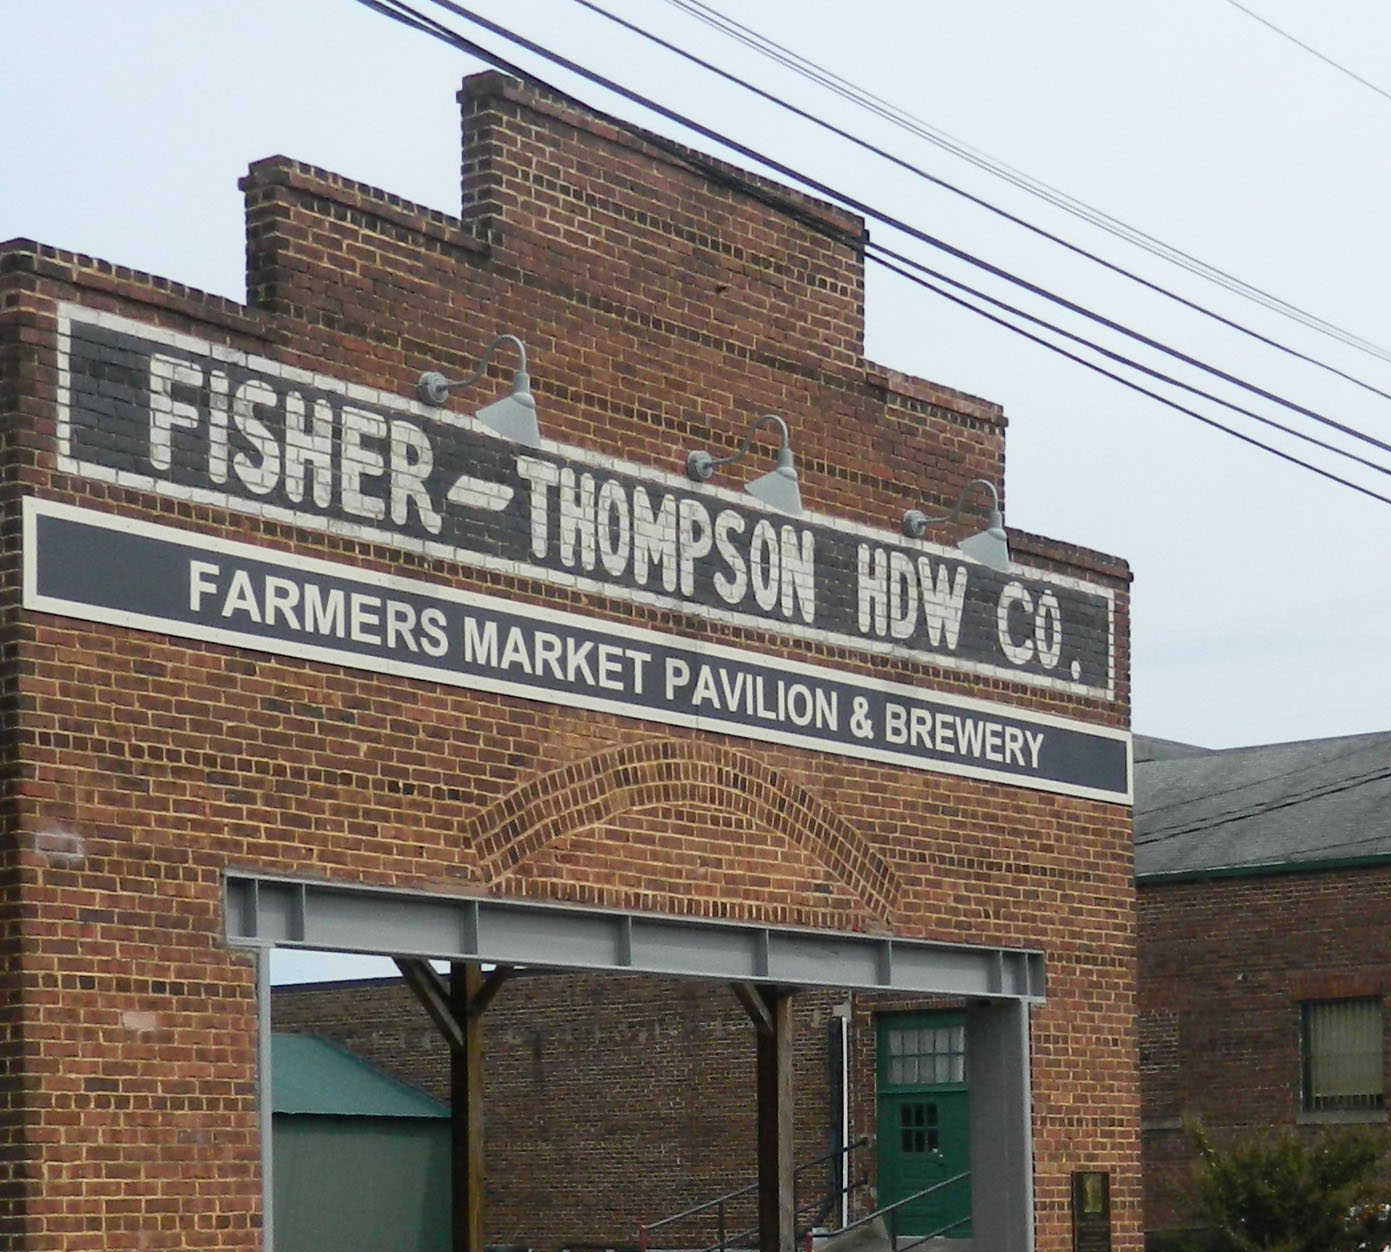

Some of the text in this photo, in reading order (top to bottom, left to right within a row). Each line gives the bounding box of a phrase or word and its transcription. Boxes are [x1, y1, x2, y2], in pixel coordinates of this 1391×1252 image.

[189, 560, 1044, 769] FARMERS MARKET PAVILION & BREWERY
[858, 543, 967, 650] HDW
[997, 580, 1082, 681] CO.
